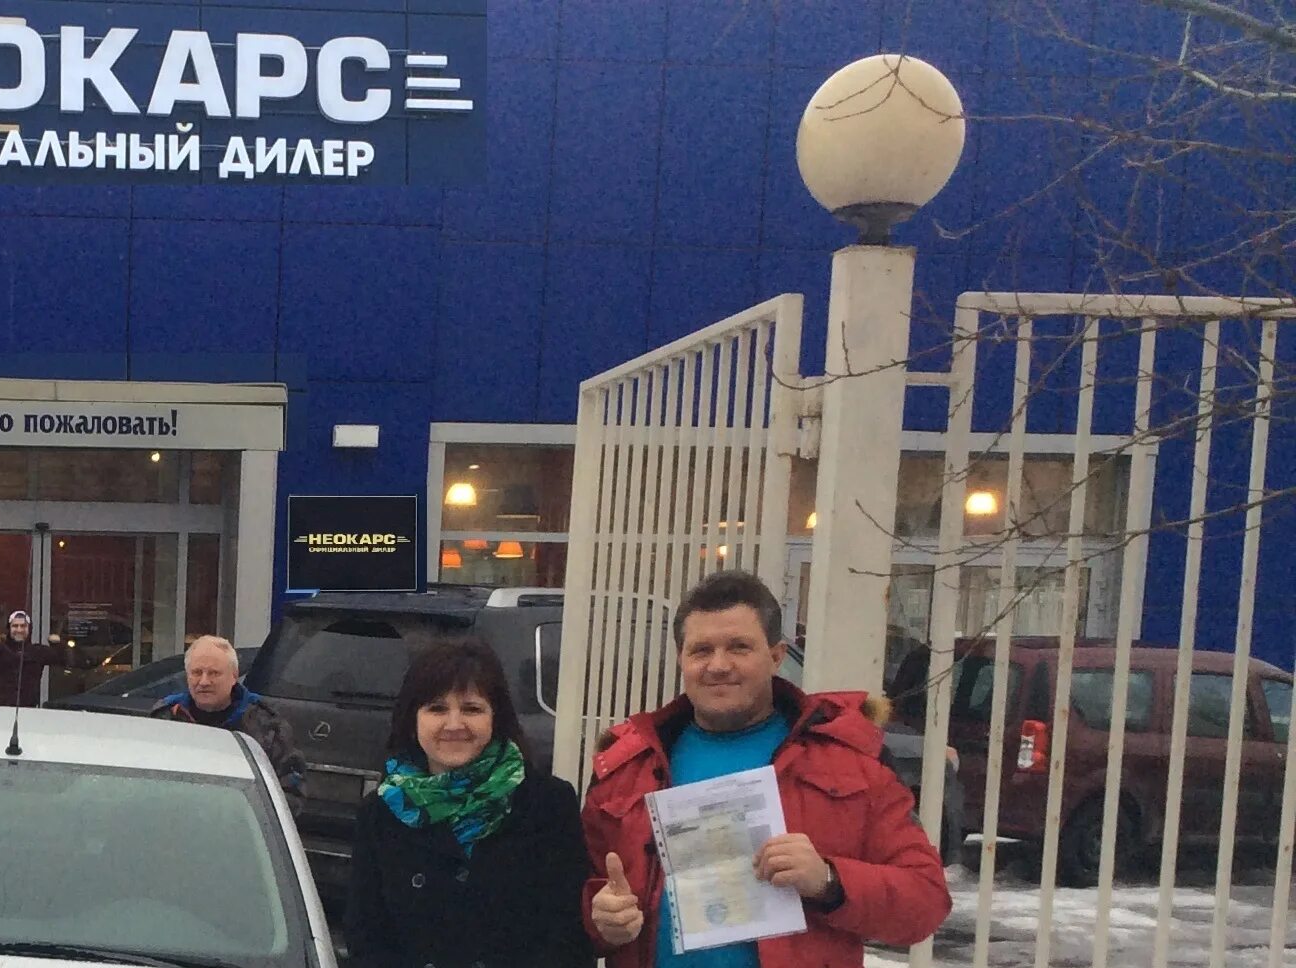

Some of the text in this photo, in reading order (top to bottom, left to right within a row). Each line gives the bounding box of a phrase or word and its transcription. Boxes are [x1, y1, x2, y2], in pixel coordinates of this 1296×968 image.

[218, 136, 375, 177] ДИЛЕР
[23, 408, 178, 437] пожаловать!
[308, 533, 396, 545] НЕОКАРС
